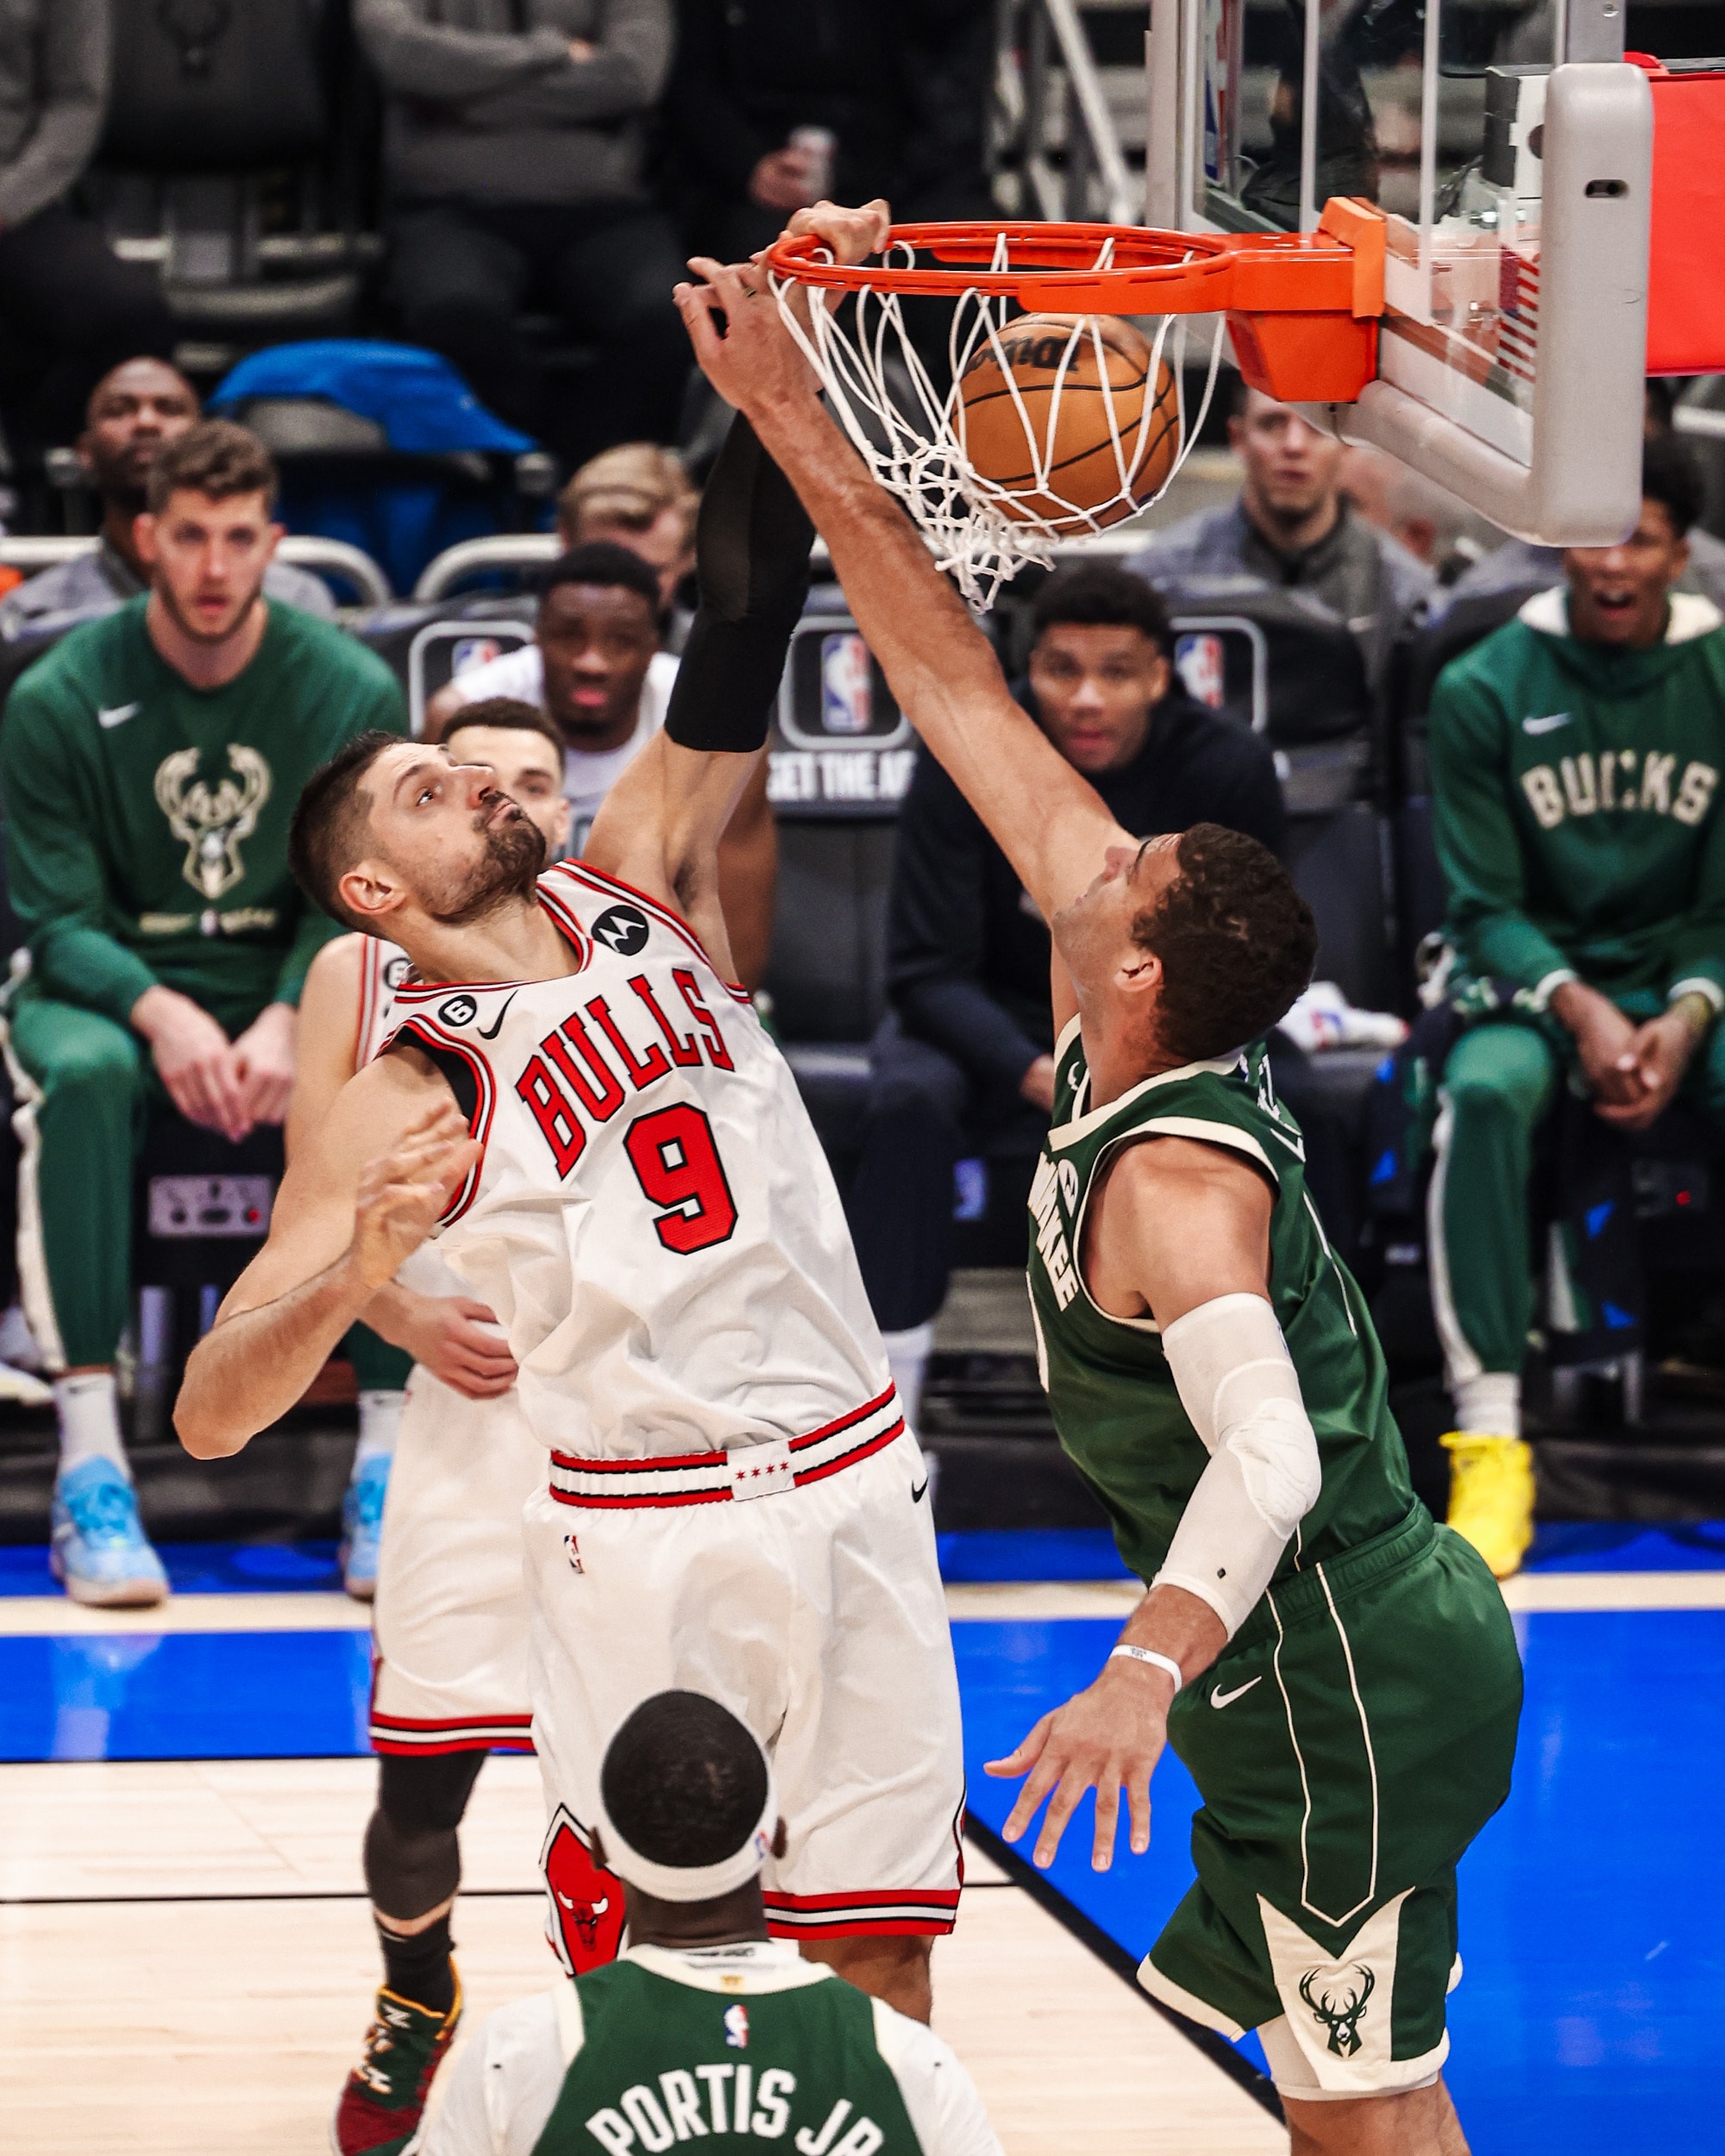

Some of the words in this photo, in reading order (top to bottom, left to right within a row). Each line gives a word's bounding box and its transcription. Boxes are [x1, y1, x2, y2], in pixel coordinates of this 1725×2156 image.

[1521, 749, 1719, 829] BUCKS
[514, 968, 736, 1181] BULLS
[623, 1100, 738, 1256] 9
[584, 2062, 798, 2156] PORTIS
